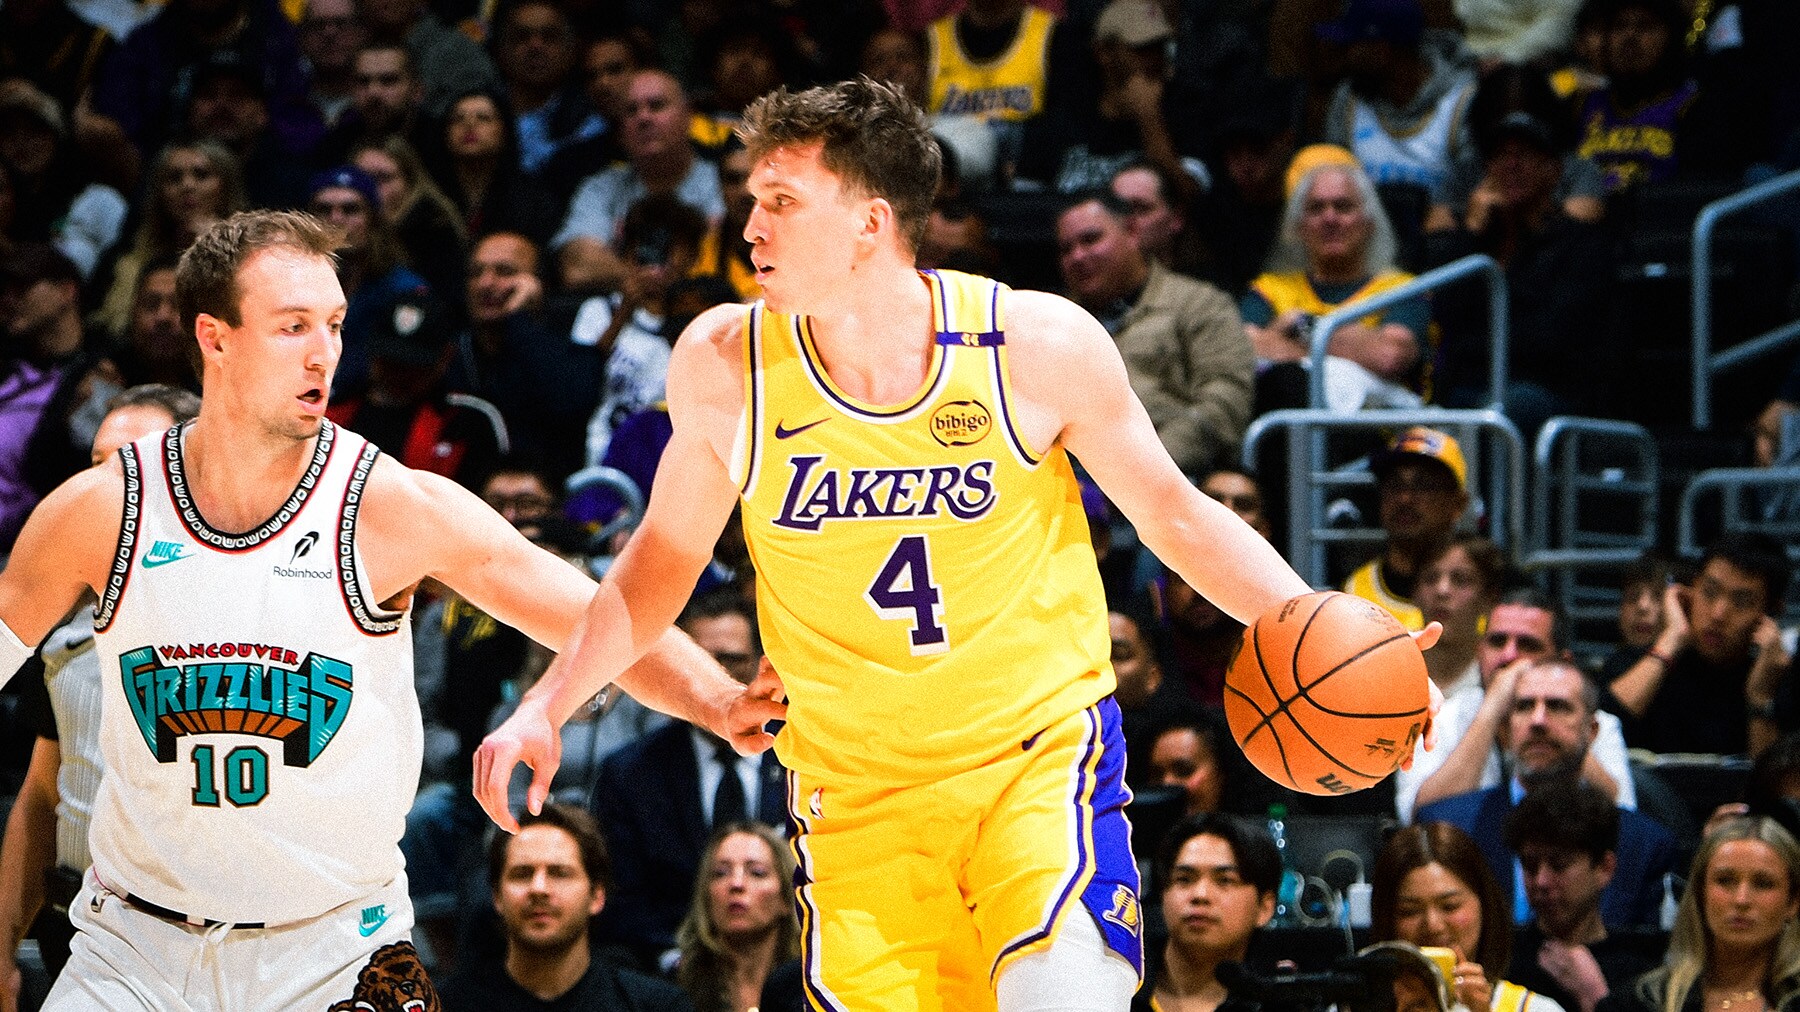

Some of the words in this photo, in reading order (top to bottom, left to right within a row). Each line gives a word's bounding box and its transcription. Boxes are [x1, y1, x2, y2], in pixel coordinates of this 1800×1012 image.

[935, 413, 987, 432] bibigo
[771, 455, 998, 533] LAKERS
[150, 540, 184, 559] NIKE
[273, 566, 333, 579] Robinhood
[863, 534, 950, 656] 4
[159, 643, 299, 665] VANCOUVER
[119, 646, 354, 768] GRIZZLIES
[191, 744, 270, 808] 10
[361, 904, 385, 925] NIKE
